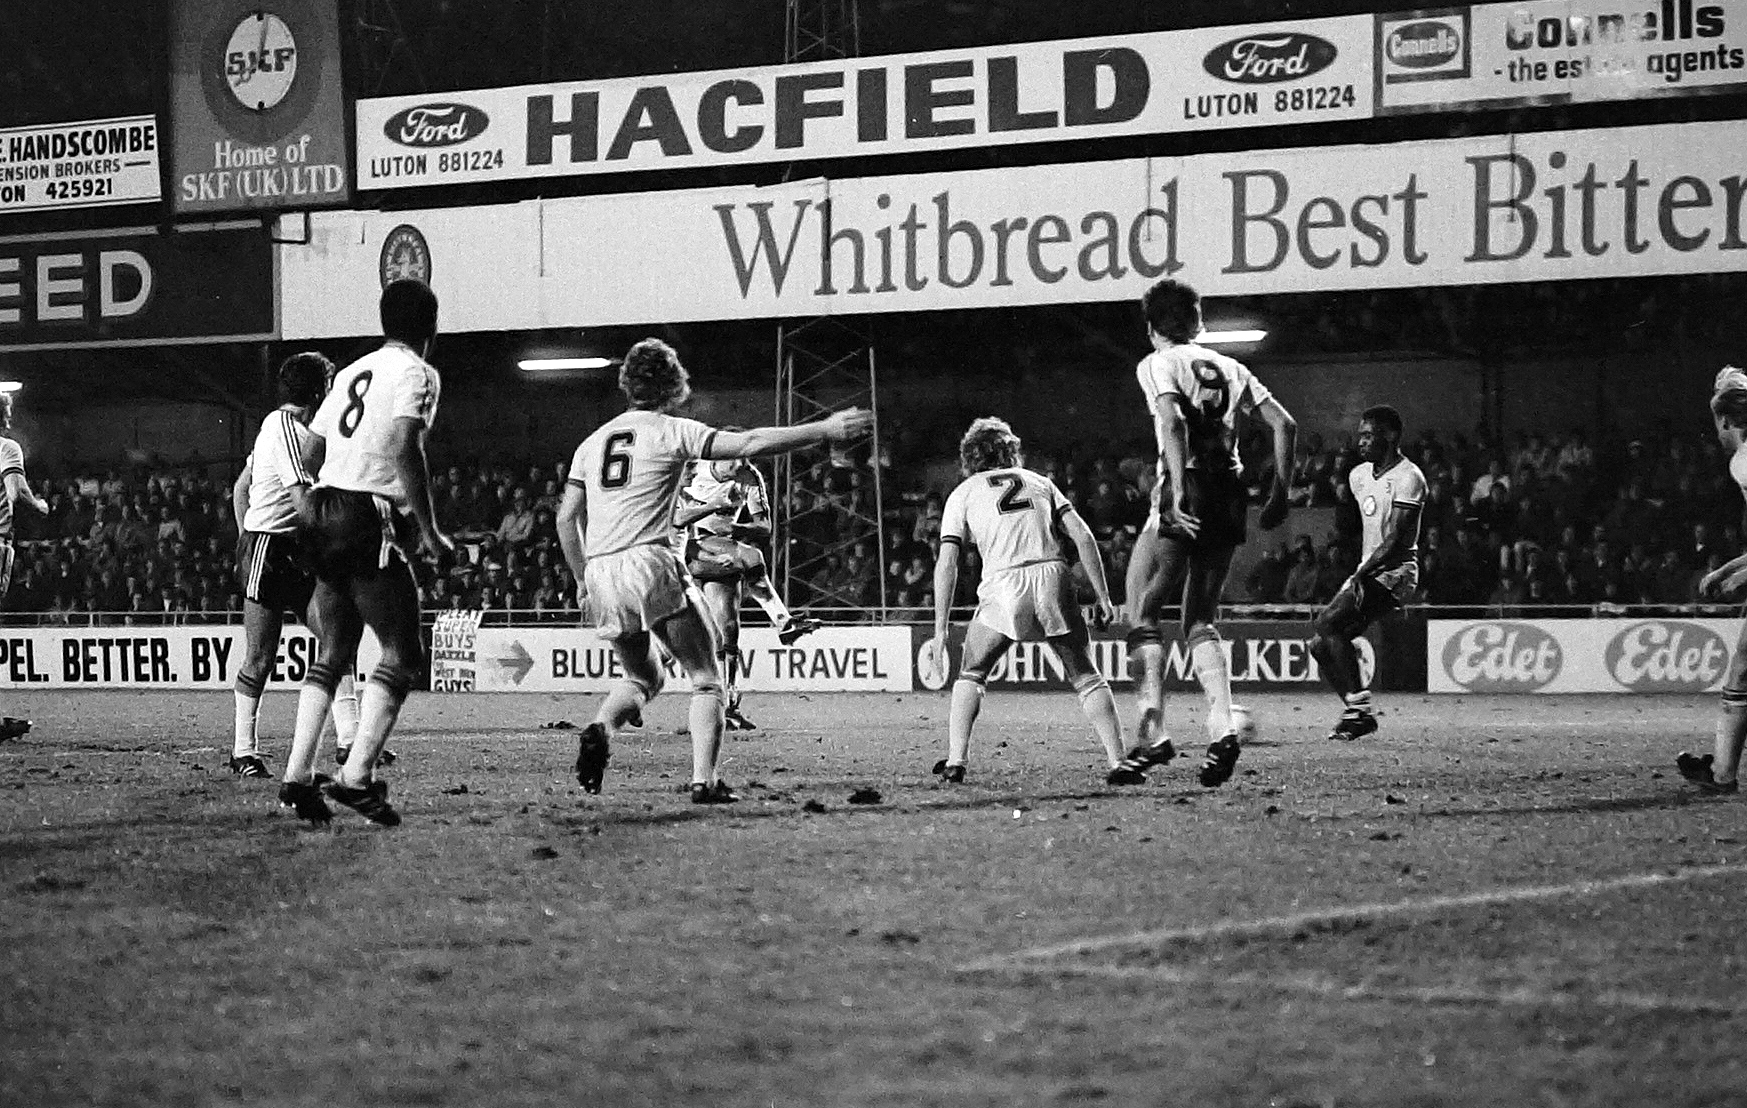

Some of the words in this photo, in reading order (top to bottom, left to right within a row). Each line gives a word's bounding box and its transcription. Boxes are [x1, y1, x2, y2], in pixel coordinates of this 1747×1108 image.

[1224, 36, 1309, 79] Ford
[1647, 44, 1744, 82] agents
[526, 47, 1151, 166] HACFIELD
[1184, 92, 1258, 119] LUTON
[1274, 84, 1356, 113] 881224
[401, 107, 468, 143] Ford
[55, 158, 121, 178] BROKERS
[214, 140, 277, 169] Home
[285, 134, 312, 163] of
[371, 154, 427, 178] LUTON
[438, 148, 504, 173] 881224
[0, 185, 26, 203] ON
[46, 178, 113, 199] 425921
[712, 176, 1184, 300] Whitbread
[1222, 168, 1429, 274] Best
[1463, 151, 1747, 264] Bitter
[338, 369, 373, 439] 8
[1191, 359, 1229, 418] 9
[601, 428, 637, 492] 6
[986, 472, 1035, 516] 2
[62, 638, 177, 682] BETTER.
[191, 637, 233, 682] BY
[435, 633, 476, 649] BUYS
[1452, 623, 1558, 685] Edet
[1614, 622, 1725, 685] Edet
[551, 649, 623, 678] BLUE
[768, 648, 888, 679] TRAVEL
